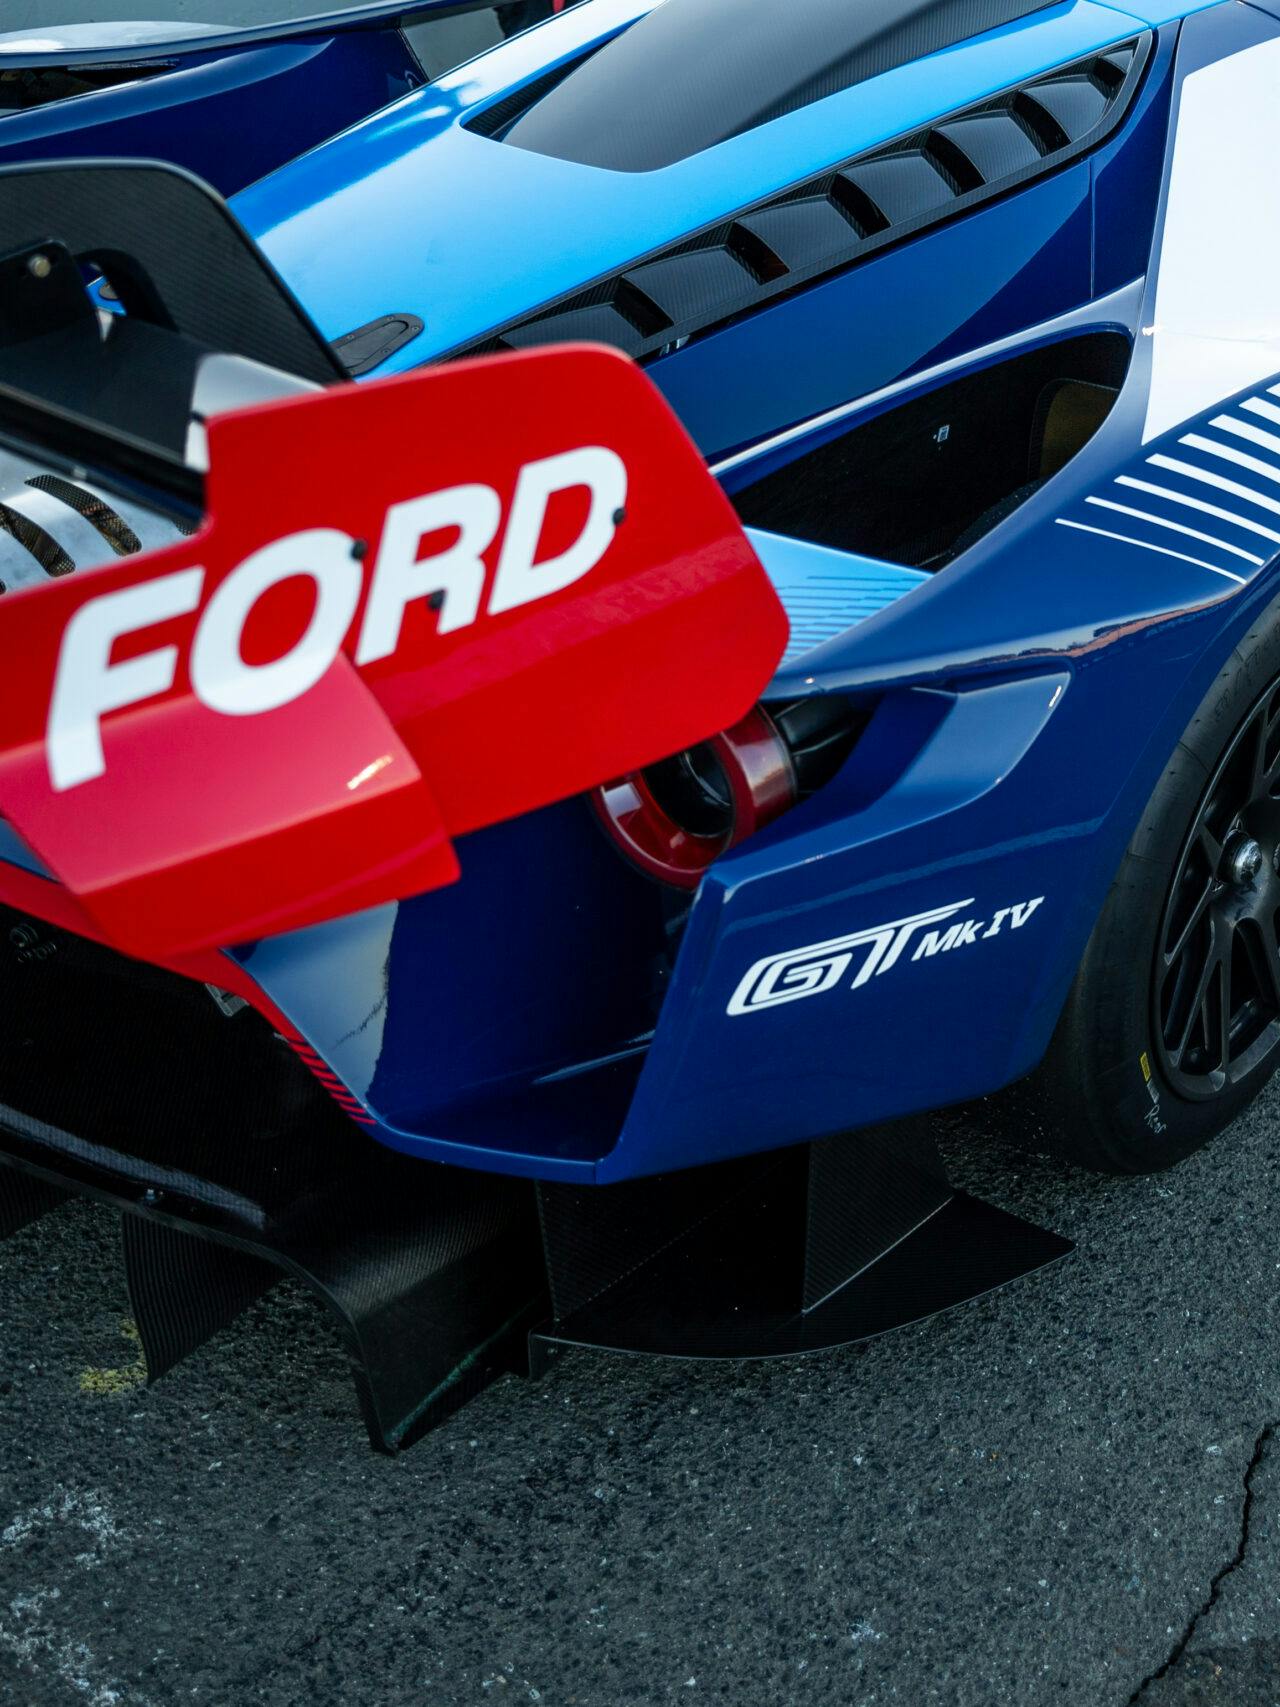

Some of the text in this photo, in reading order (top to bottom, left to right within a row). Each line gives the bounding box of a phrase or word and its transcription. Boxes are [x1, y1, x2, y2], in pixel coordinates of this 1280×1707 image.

[46, 446, 628, 793] FORD
[726, 897, 976, 1017] GT
[982, 896, 1046, 940] IV
